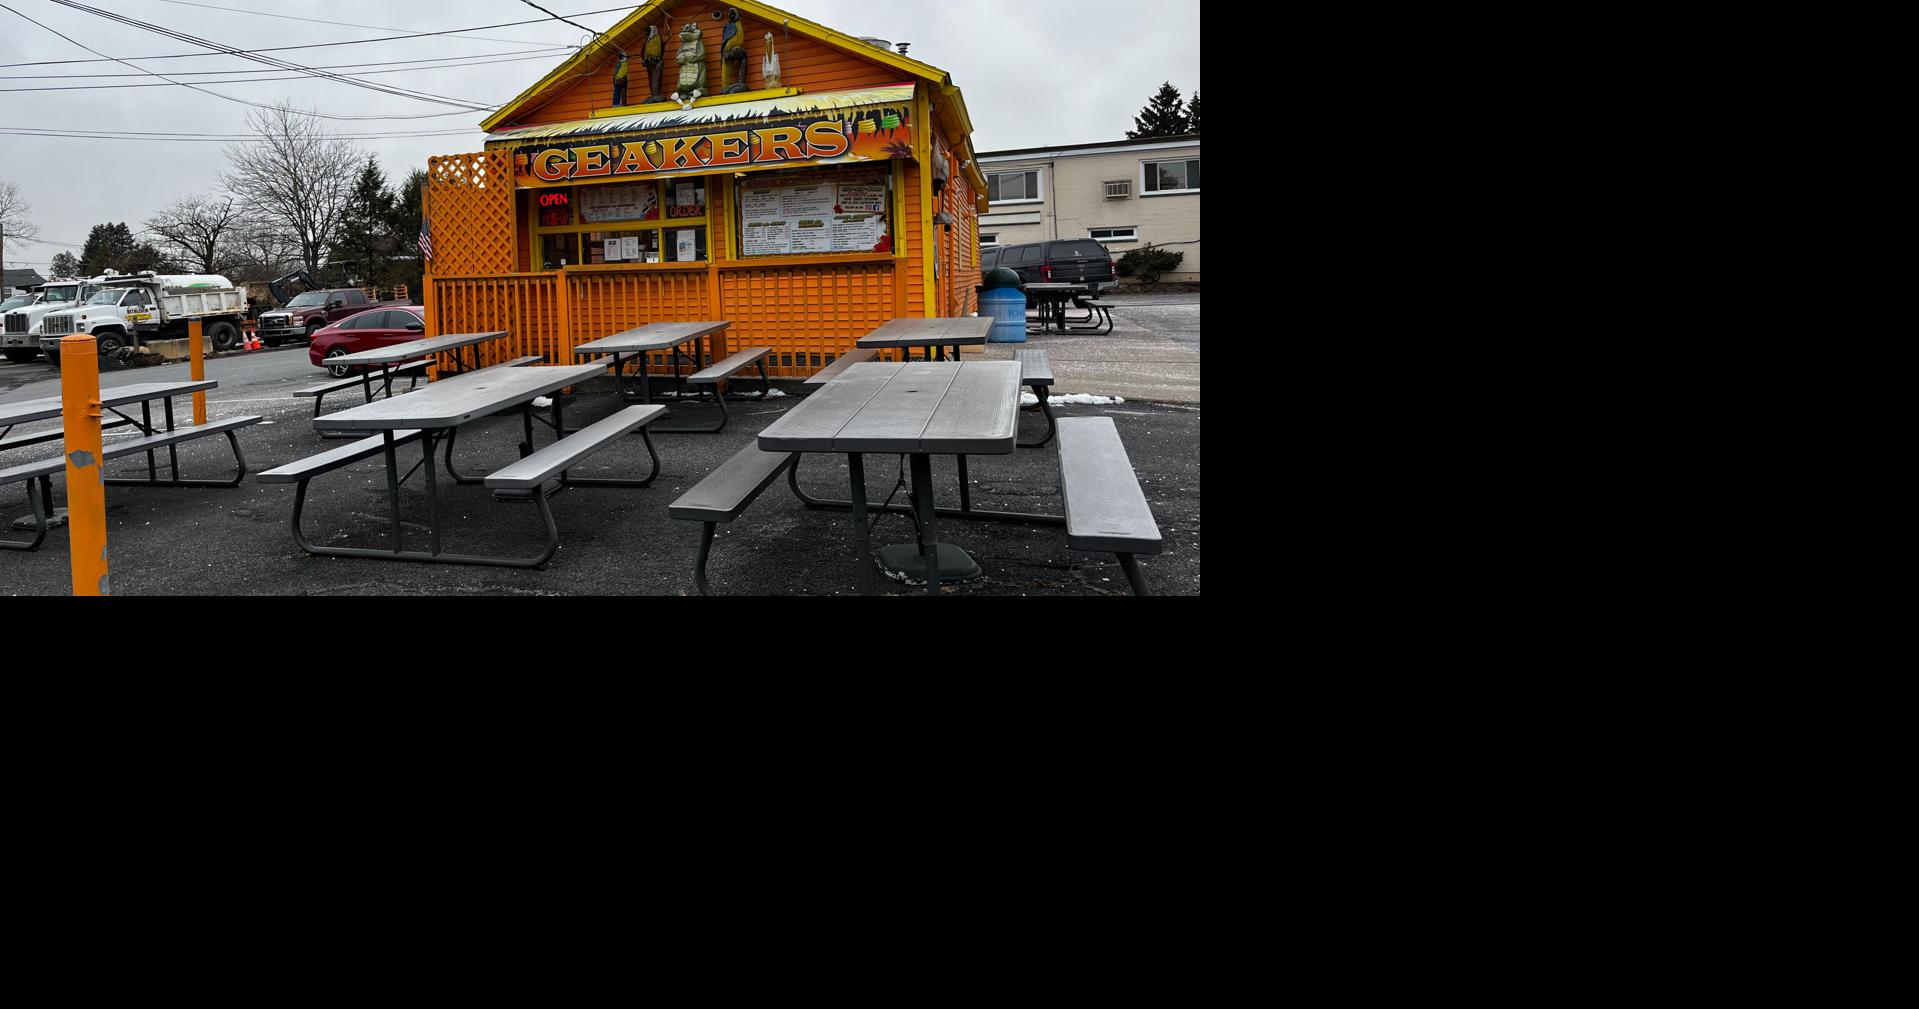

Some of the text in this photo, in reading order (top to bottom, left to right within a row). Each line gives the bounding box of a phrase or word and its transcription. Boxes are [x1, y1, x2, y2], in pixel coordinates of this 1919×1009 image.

[533, 120, 848, 179] GEAKERS
[539, 193, 568, 206] OPEN
[669, 205, 703, 217] ORDER
